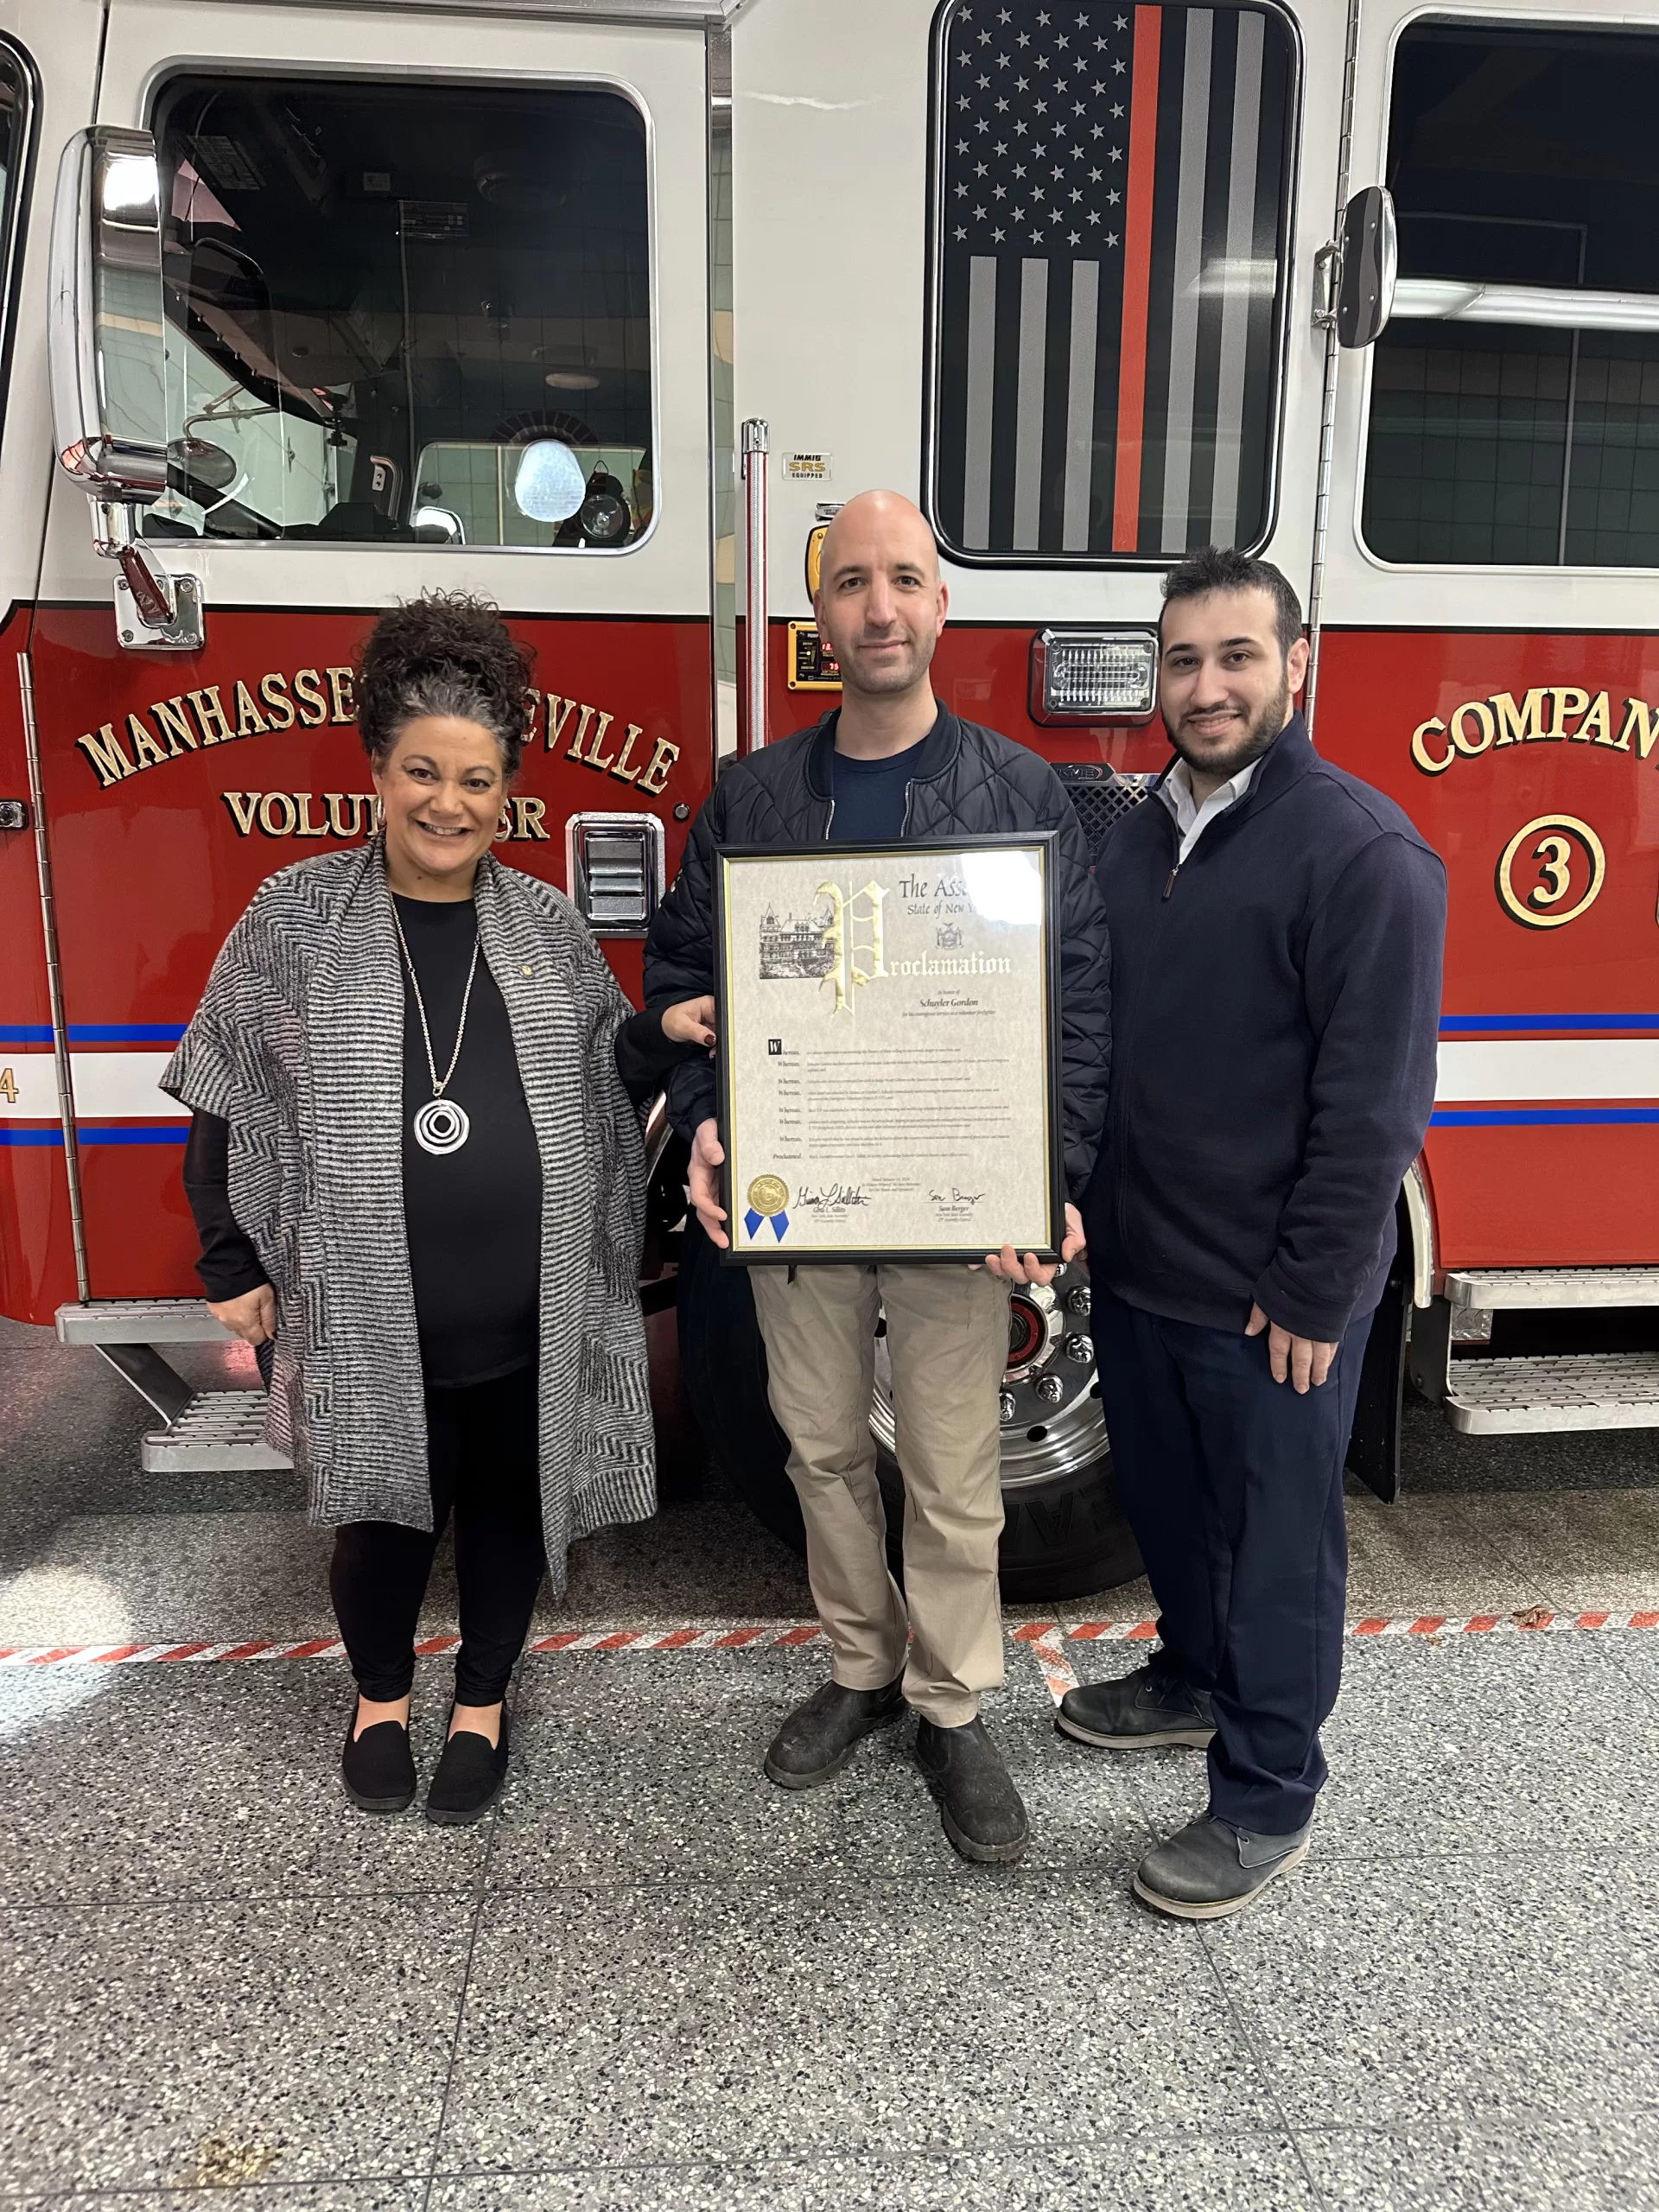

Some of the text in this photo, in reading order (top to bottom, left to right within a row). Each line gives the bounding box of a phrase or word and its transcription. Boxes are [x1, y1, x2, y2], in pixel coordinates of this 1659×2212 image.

[789, 461, 826, 472] SRS
[74, 667, 366, 790] MANHASSE
[1410, 687, 1659, 775] COMPAN
[899, 873, 928, 898] The
[1530, 836, 1572, 906] 3
[907, 903, 931, 915] State
[933, 899, 944, 919] of
[945, 903, 964, 913] New
[919, 997, 979, 1009] Schuyler Gordon
[0, 1067, 19, 1103] 4
